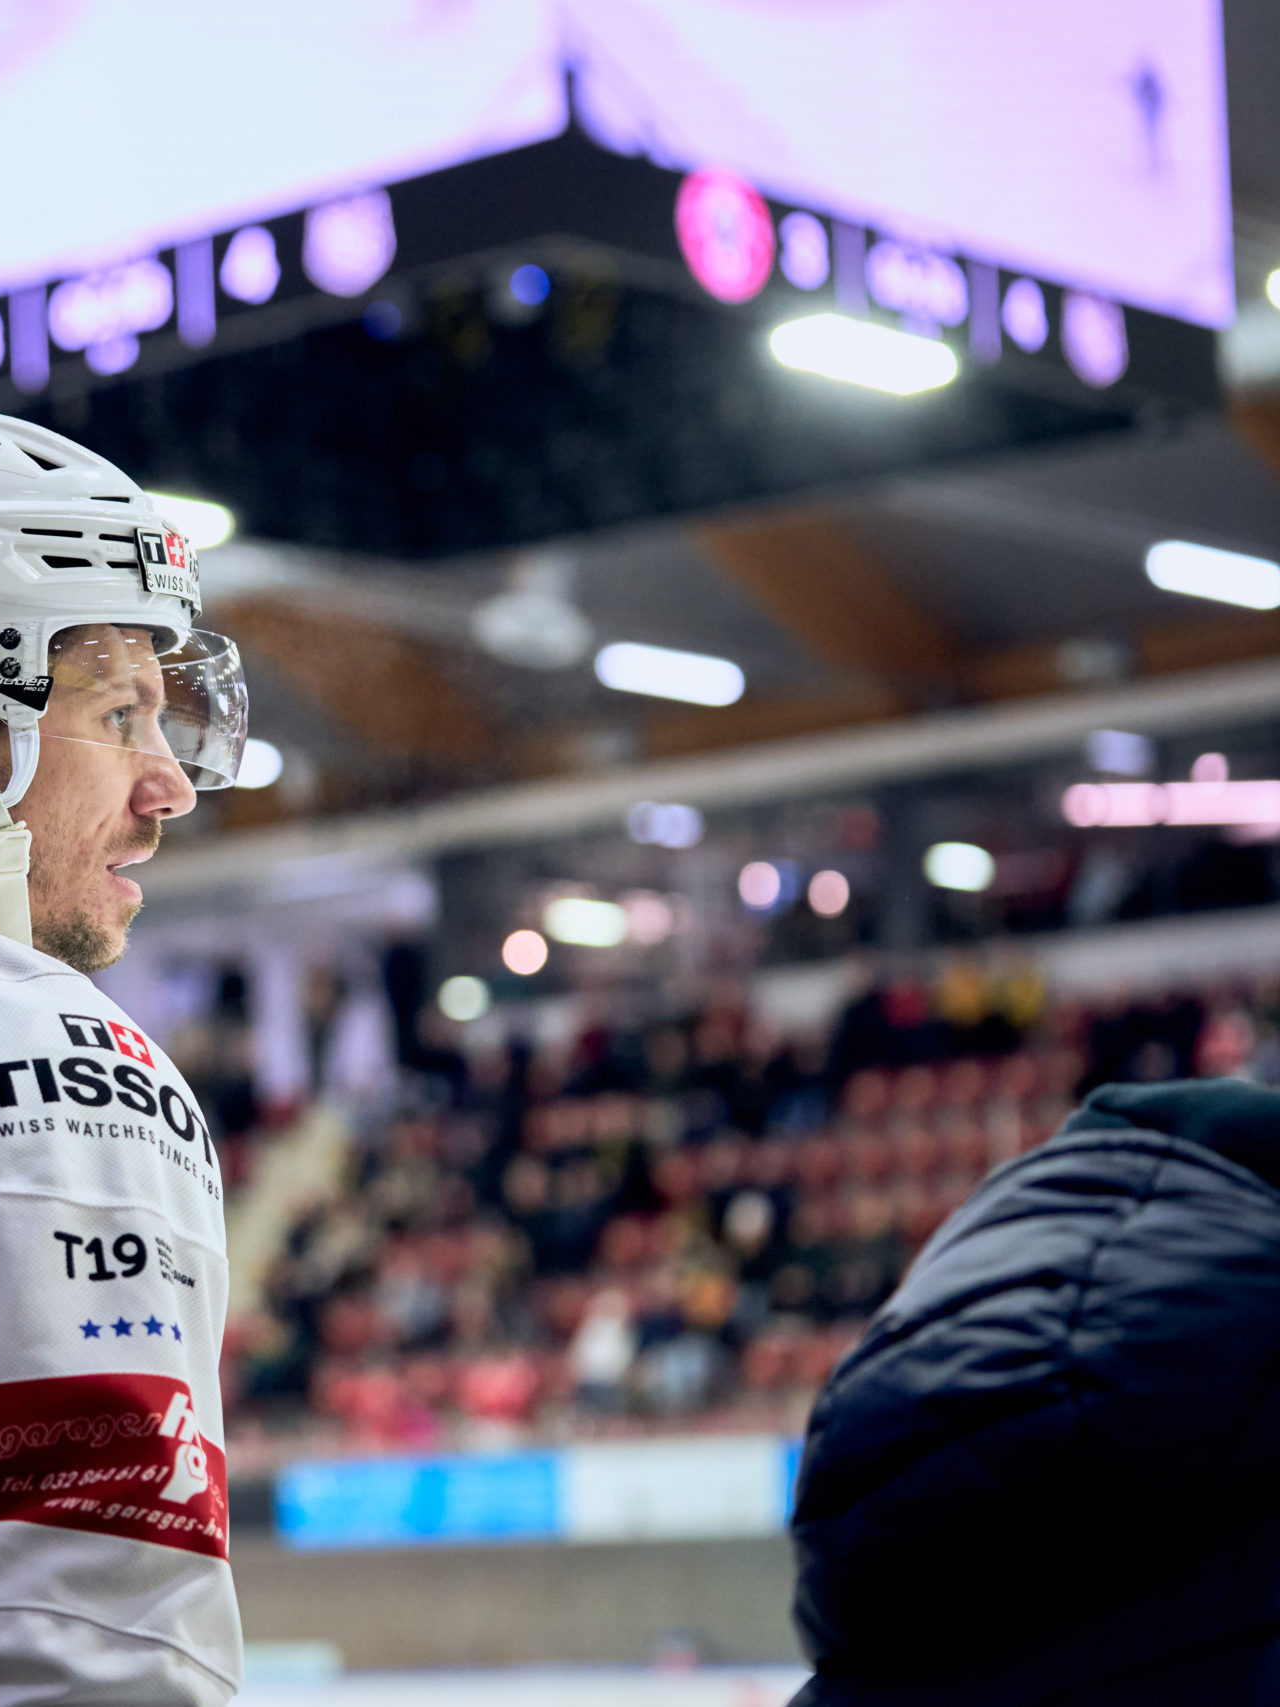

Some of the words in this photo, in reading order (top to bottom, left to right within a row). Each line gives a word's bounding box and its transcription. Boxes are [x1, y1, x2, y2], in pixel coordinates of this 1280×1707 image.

[66, 1118, 156, 1145] WATCHES
[159, 1139, 198, 1178] SINCE
[201, 1174, 220, 1201] 185
[54, 1231, 148, 1281] T19
